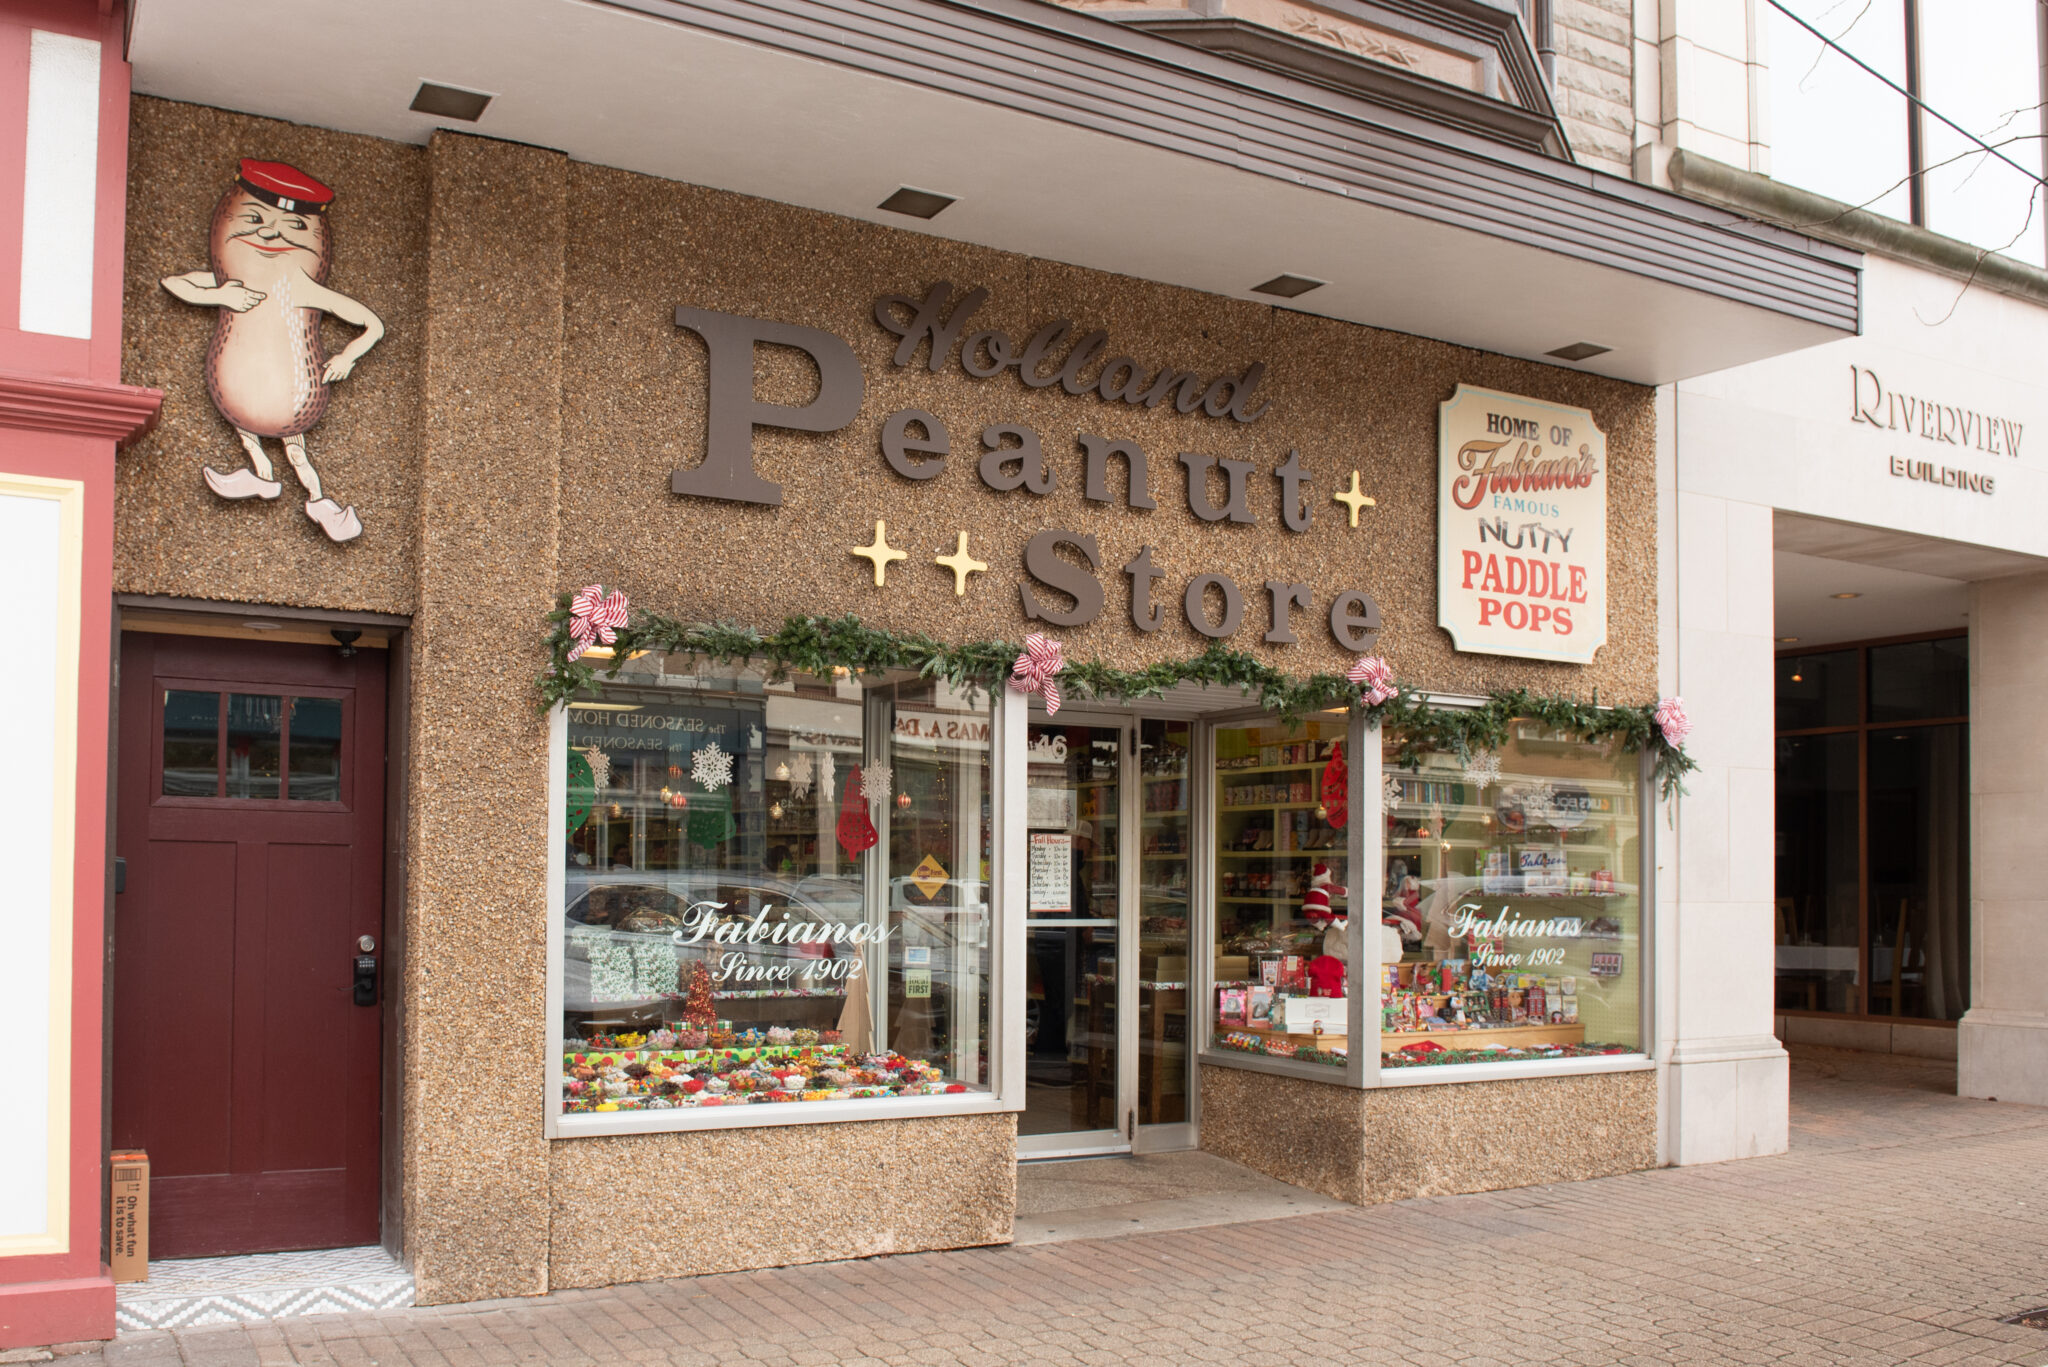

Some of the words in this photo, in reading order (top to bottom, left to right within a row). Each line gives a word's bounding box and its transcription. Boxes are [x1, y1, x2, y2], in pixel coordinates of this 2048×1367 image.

[874, 281, 1271, 423] Holland
[671, 305, 1315, 533] Peanut
[1850, 364, 2023, 458] RIVERVIEW
[1486, 412, 1540, 441] HOME
[1550, 424, 1573, 447] OF
[1452, 438, 1600, 510] Fabiano's
[1889, 455, 1995, 495] BUILDING
[1493, 495, 1560, 518] FAMOUS
[1478, 516, 1574, 554] NUTTY
[1019, 530, 1383, 652] Store
[1461, 549, 1588, 604] PADDLE
[1478, 597, 1574, 636] POPS
[672, 901, 899, 945] Fabianos
[1447, 903, 1587, 939] Fabianos
[711, 952, 797, 982] Since
[801, 958, 863, 980] 1902
[1472, 942, 1525, 967] Since
[1527, 948, 1566, 966] 1902
[116, 1196, 126, 1204] it
[116, 1206, 126, 1215] is
[127, 1195, 138, 1210] Oh
[115, 1217, 125, 1228] to
[126, 1211, 137, 1239] what
[115, 1230, 124, 1256] save.
[126, 1240, 138, 1258] fun
